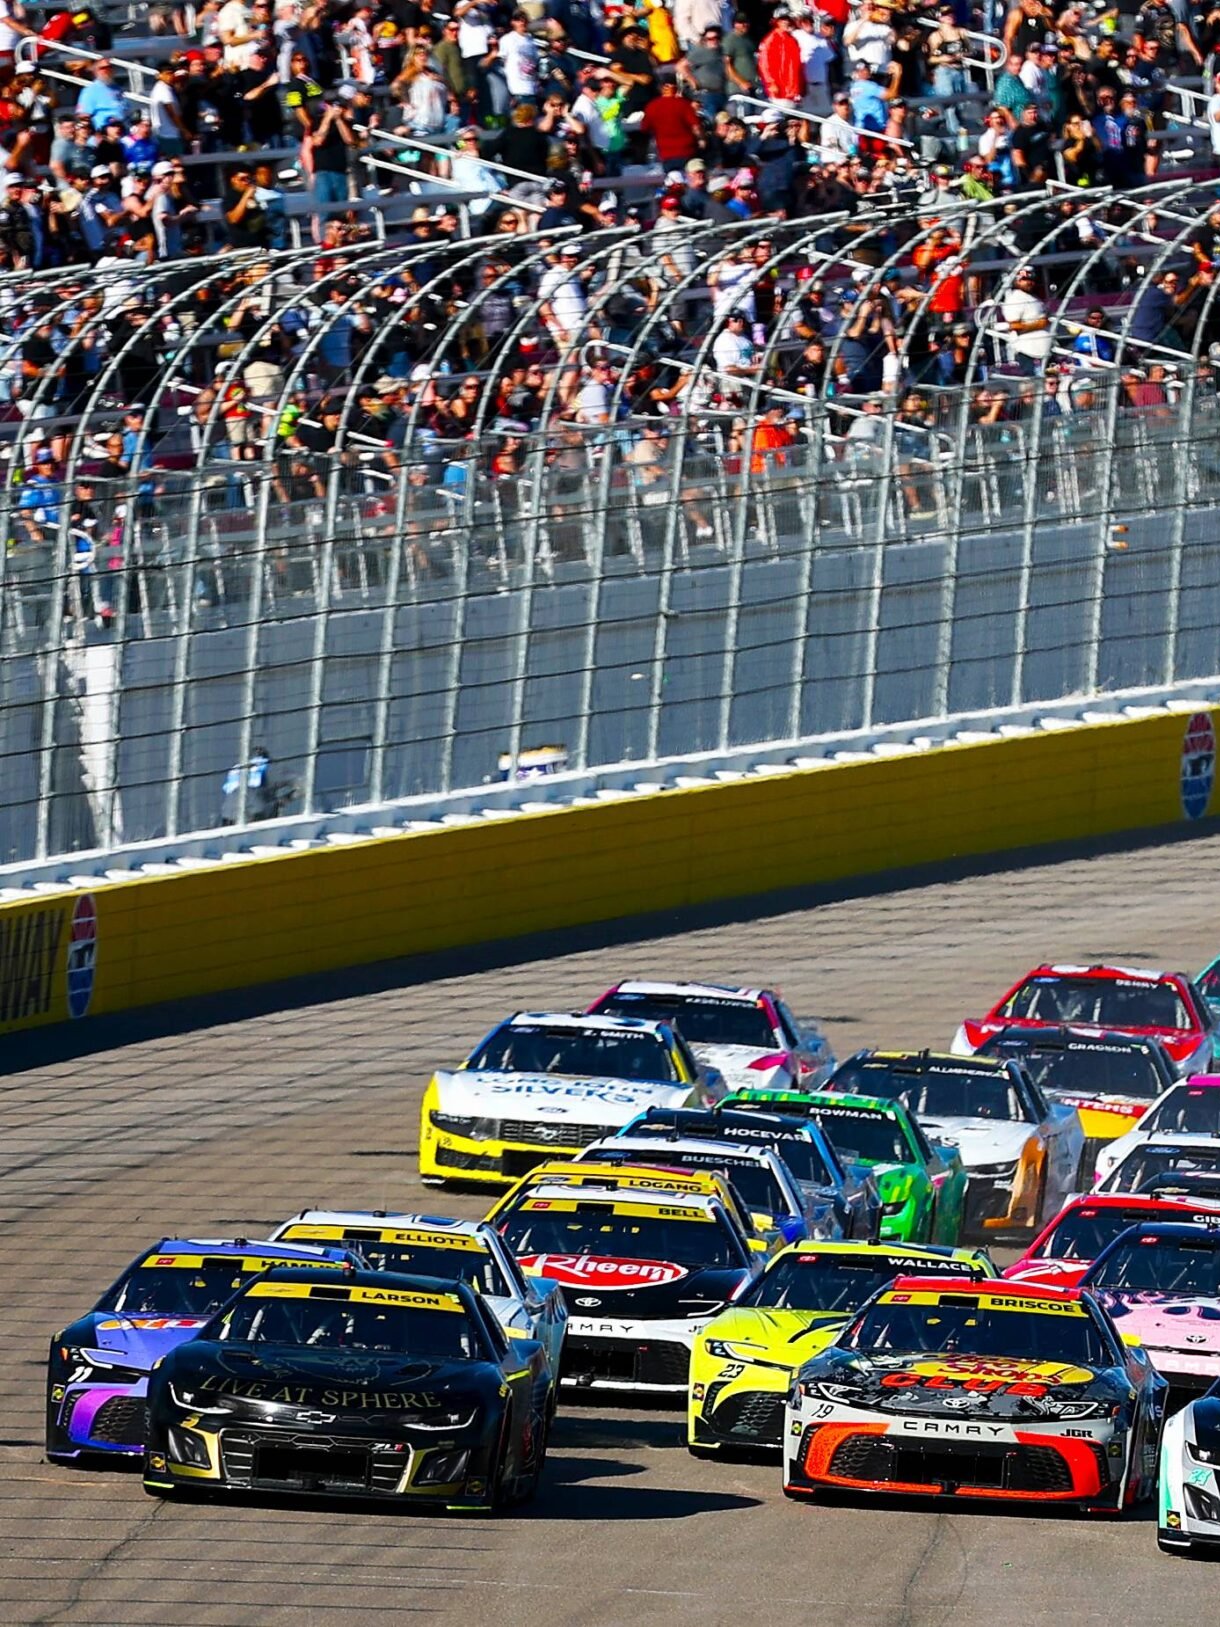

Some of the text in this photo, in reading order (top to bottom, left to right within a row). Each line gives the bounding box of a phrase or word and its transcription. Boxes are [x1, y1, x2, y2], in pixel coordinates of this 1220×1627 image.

[1067, 1043, 1132, 1053] GRAGSON
[809, 1107, 883, 1120] BOWMAN
[628, 1179, 702, 1193] LOGANO
[657, 1207, 705, 1219] BELL
[394, 1232, 470, 1247] ELLIOTT
[533, 1253, 675, 1282] Rheem
[886, 1256, 973, 1273] WALLACE
[361, 1290, 441, 1306] LARSON
[990, 1296, 1077, 1313] BRISCOE
[67, 1366, 94, 1383] 11
[717, 1363, 746, 1379] 23
[200, 1374, 442, 1409] LIVE AT SPHERE
[880, 1373, 1050, 1398] CLUB
[809, 1401, 836, 1419] 19
[902, 1420, 1006, 1437] CAMRY
[1059, 1428, 1095, 1439] JGR
